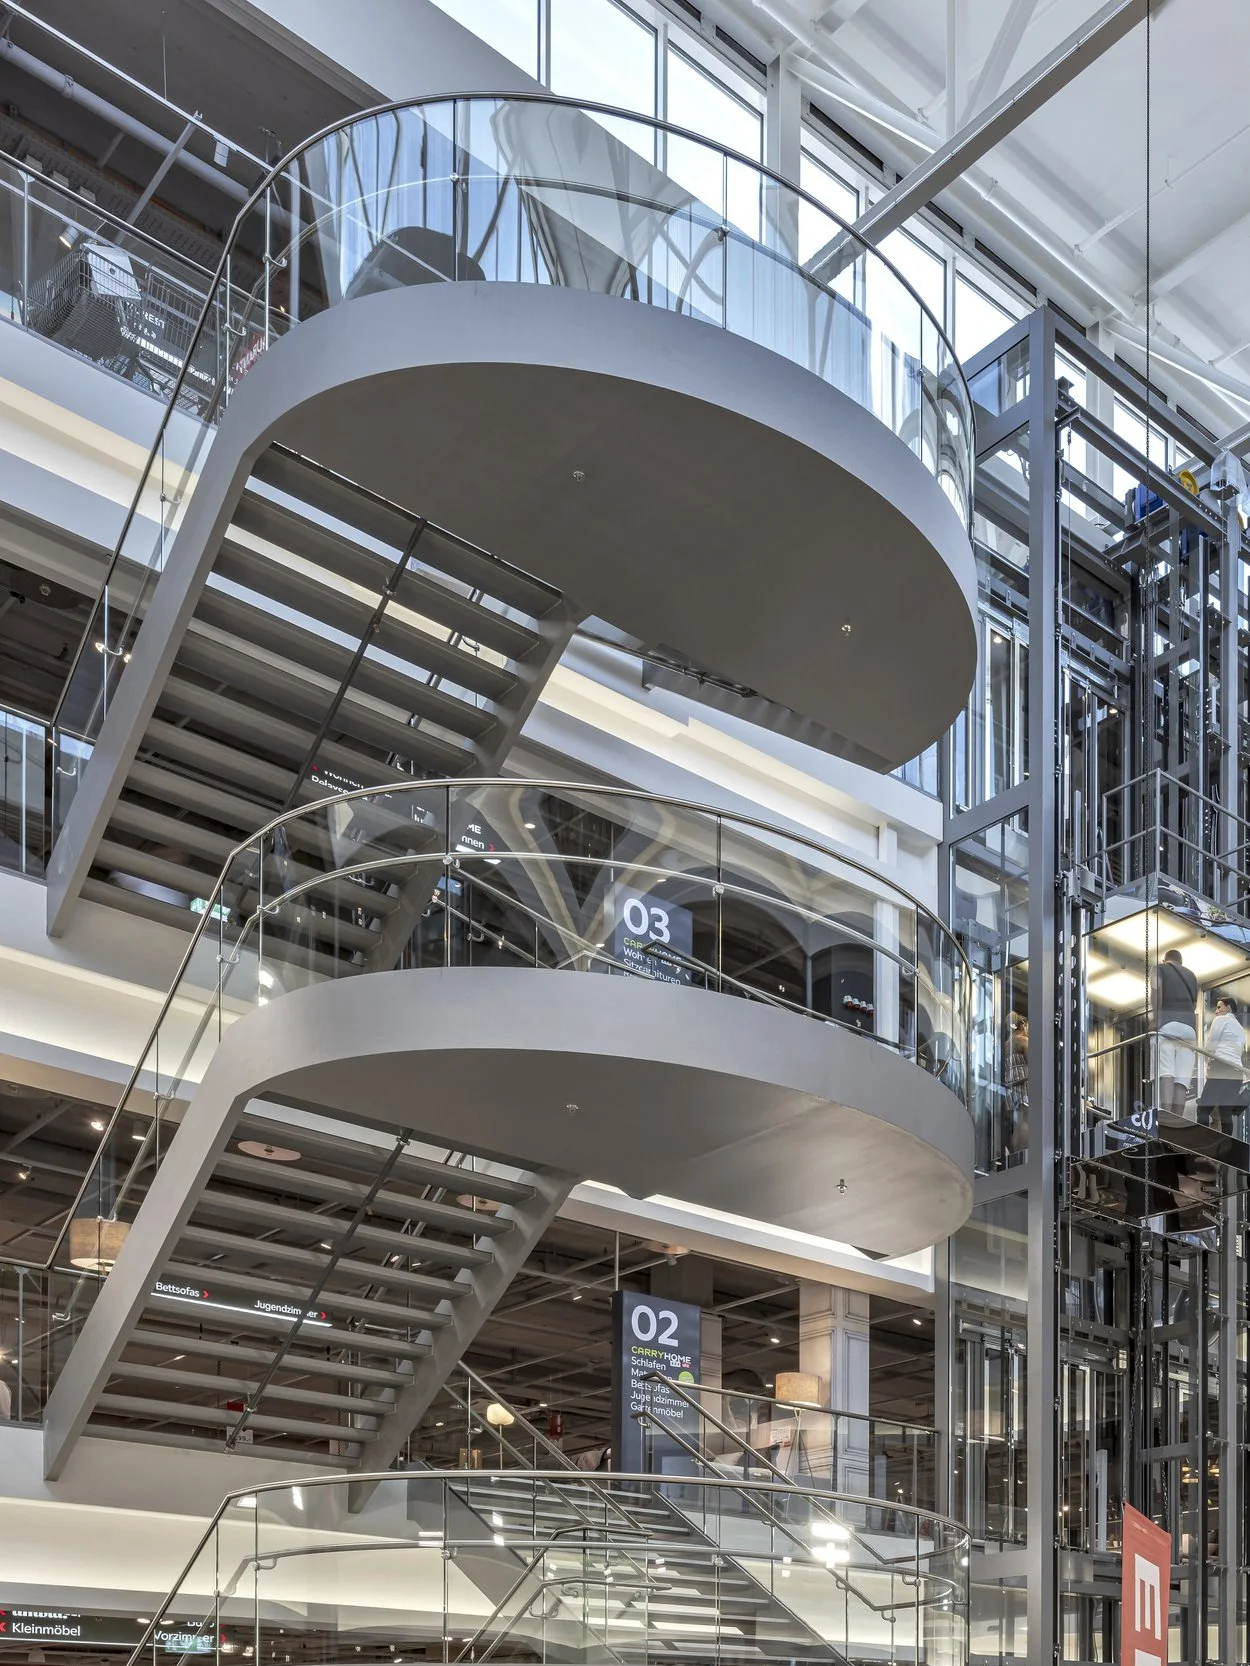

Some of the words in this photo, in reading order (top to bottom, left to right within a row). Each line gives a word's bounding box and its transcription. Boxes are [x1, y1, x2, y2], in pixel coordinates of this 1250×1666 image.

[623, 898, 671, 944] 03
[155, 1281, 200, 1298] Bettsofas
[254, 1299, 319, 1318] Jugendzimer
[631, 1304, 679, 1348] 02
[631, 1345, 692, 1365] CARRYHOME
[631, 1356, 667, 1371] Schlafen
[11, 1622, 82, 1637] Kleinmöbel
